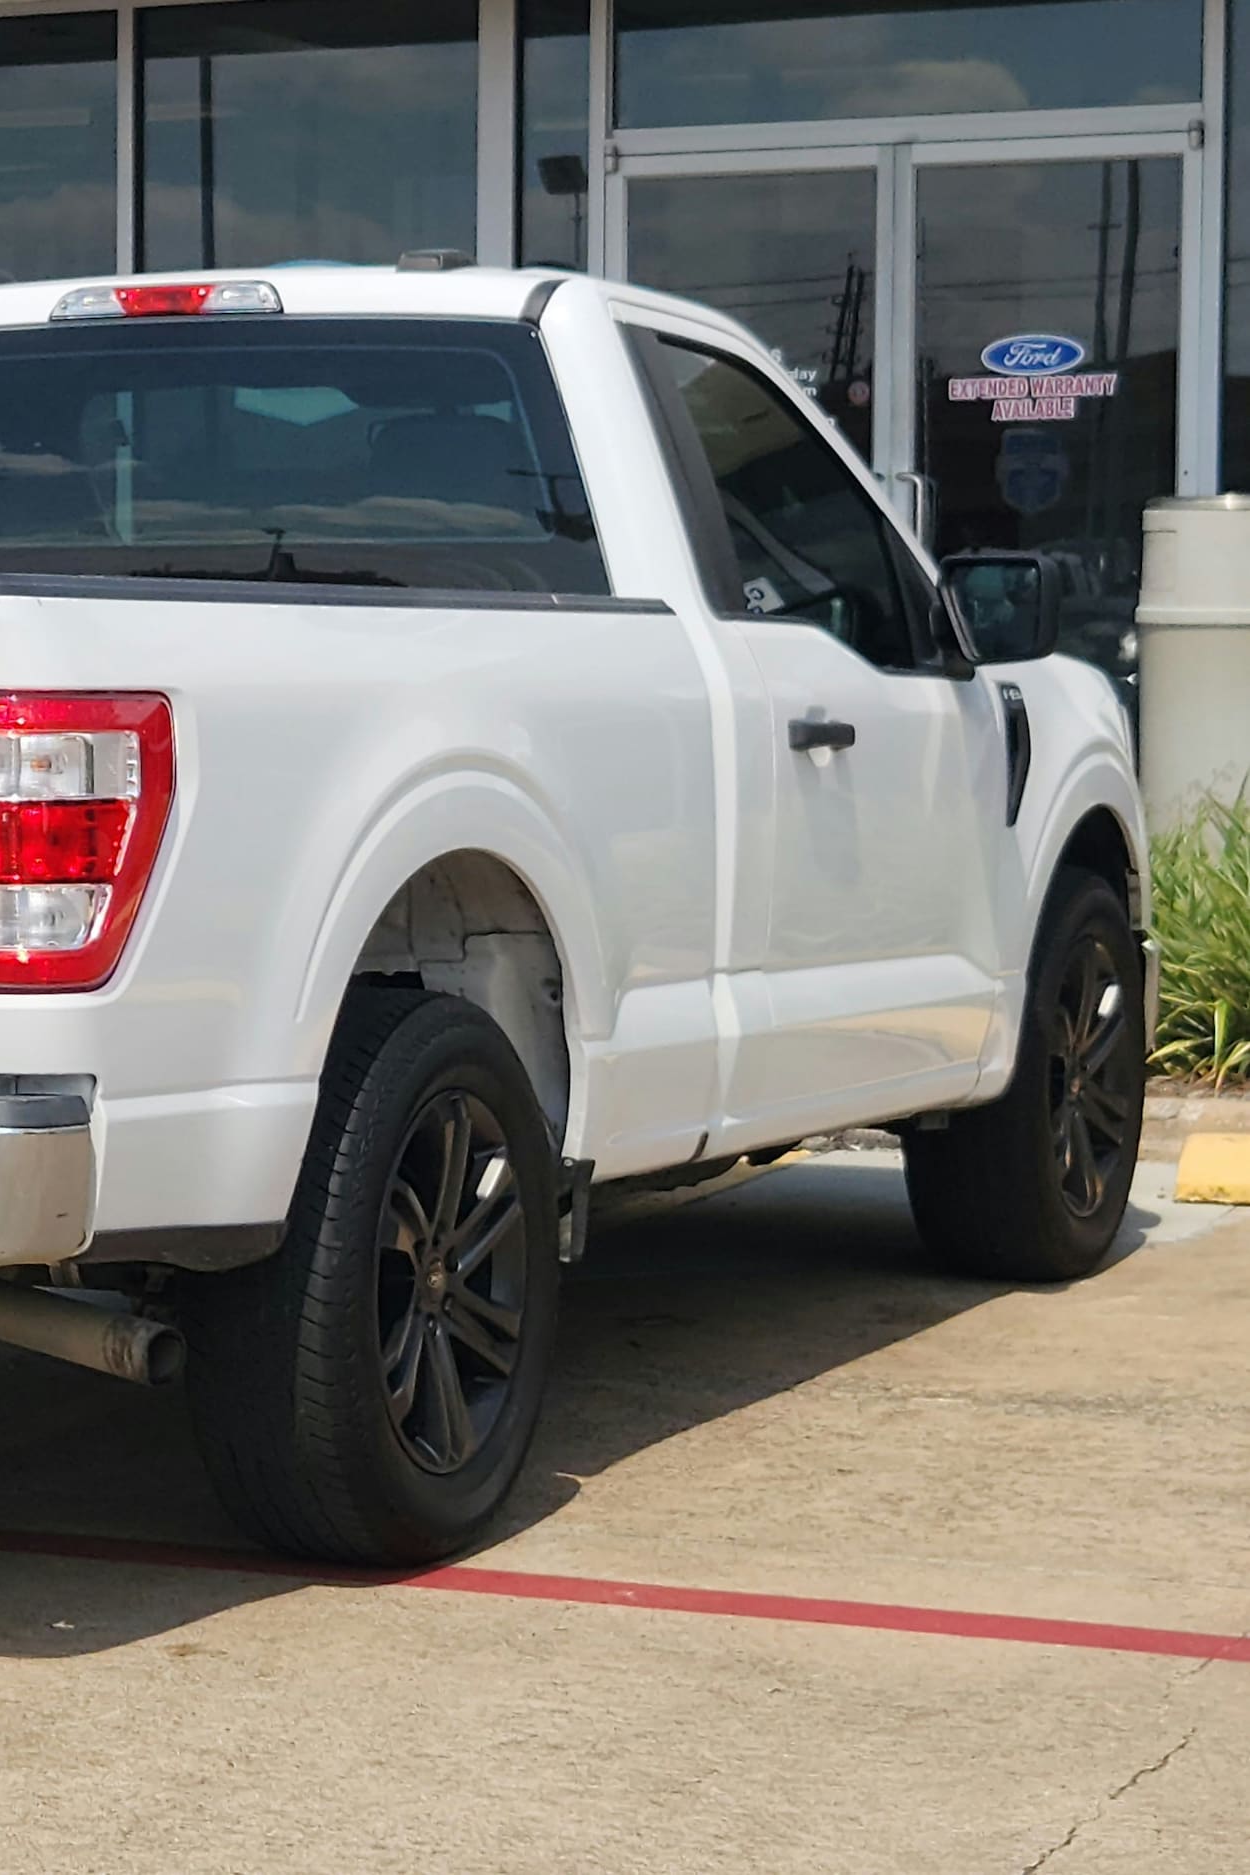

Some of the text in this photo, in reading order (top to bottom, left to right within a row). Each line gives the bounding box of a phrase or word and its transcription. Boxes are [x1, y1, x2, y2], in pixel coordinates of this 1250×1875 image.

[1003, 341, 1063, 368] Ford
[950, 374, 1117, 399] EXTENDED WARRANTY
[991, 399, 1075, 421] AVAILABLE
